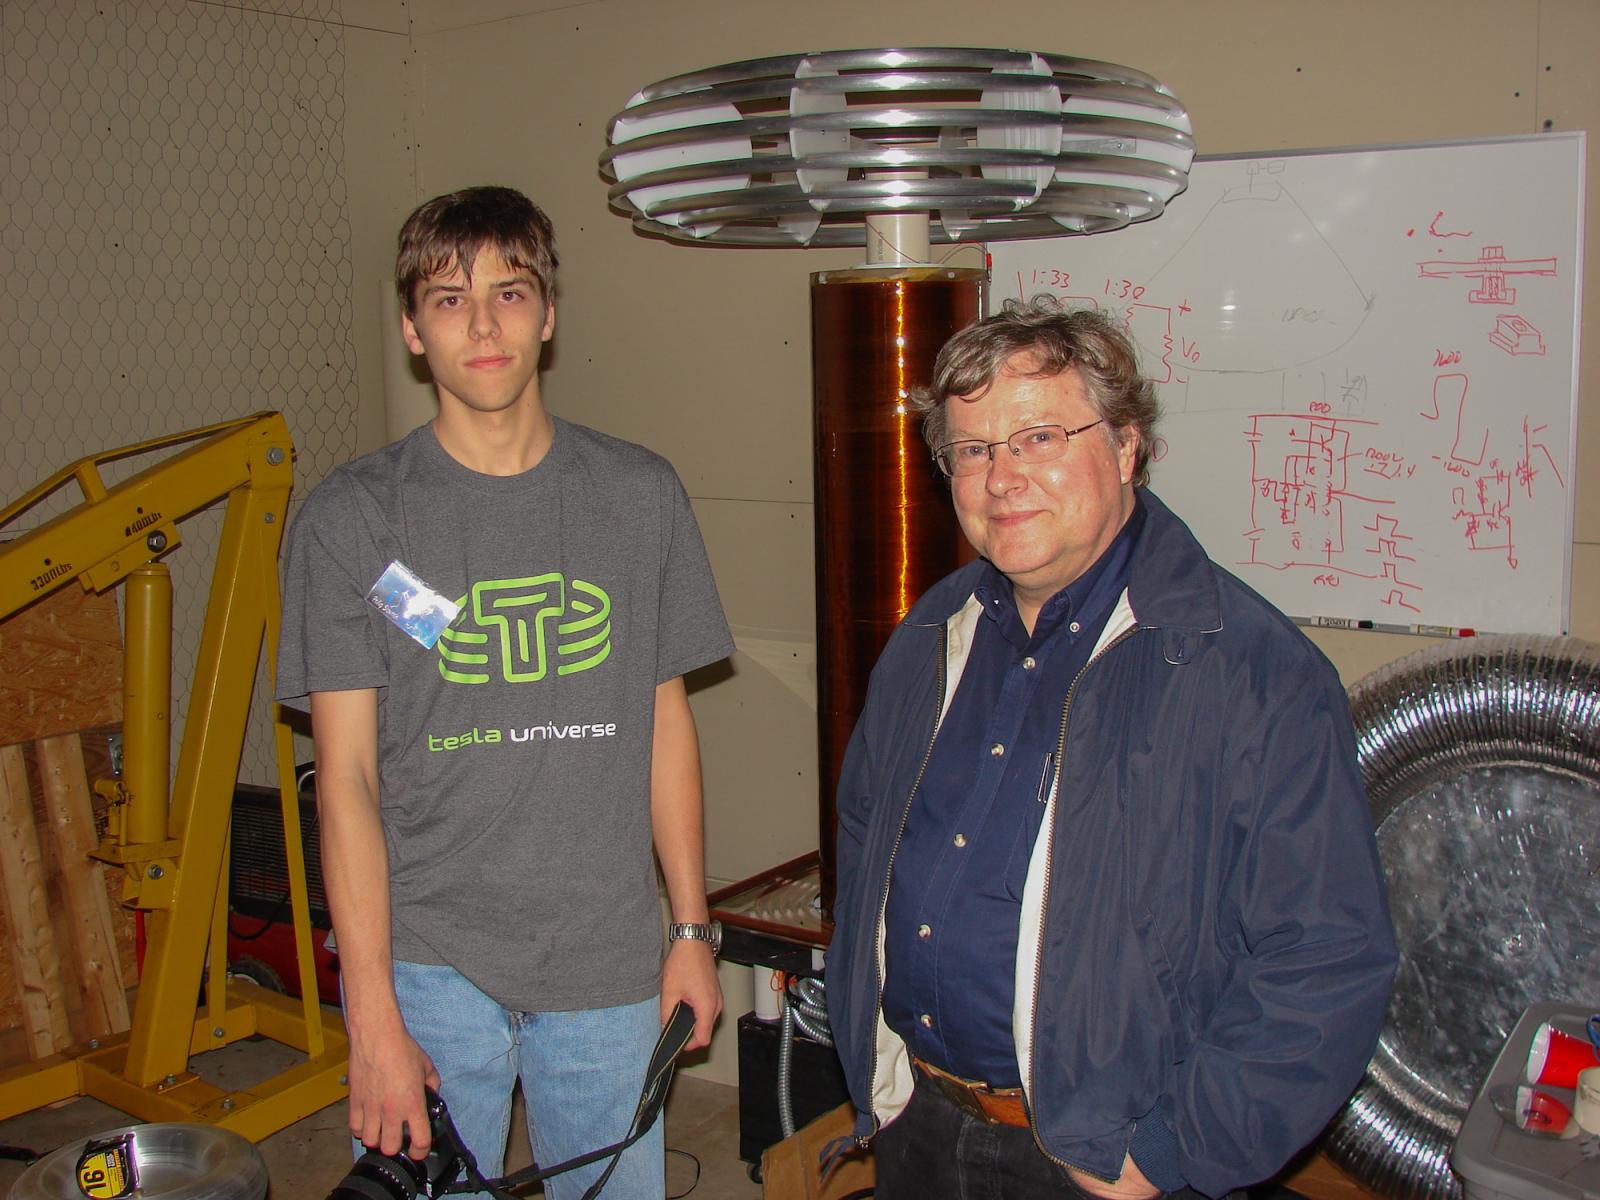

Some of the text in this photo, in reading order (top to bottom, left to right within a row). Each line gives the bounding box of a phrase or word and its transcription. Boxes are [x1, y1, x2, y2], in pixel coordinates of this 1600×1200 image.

[1032, 269, 1071, 289] 1:33
[428, 721, 617, 752] tesla universe
